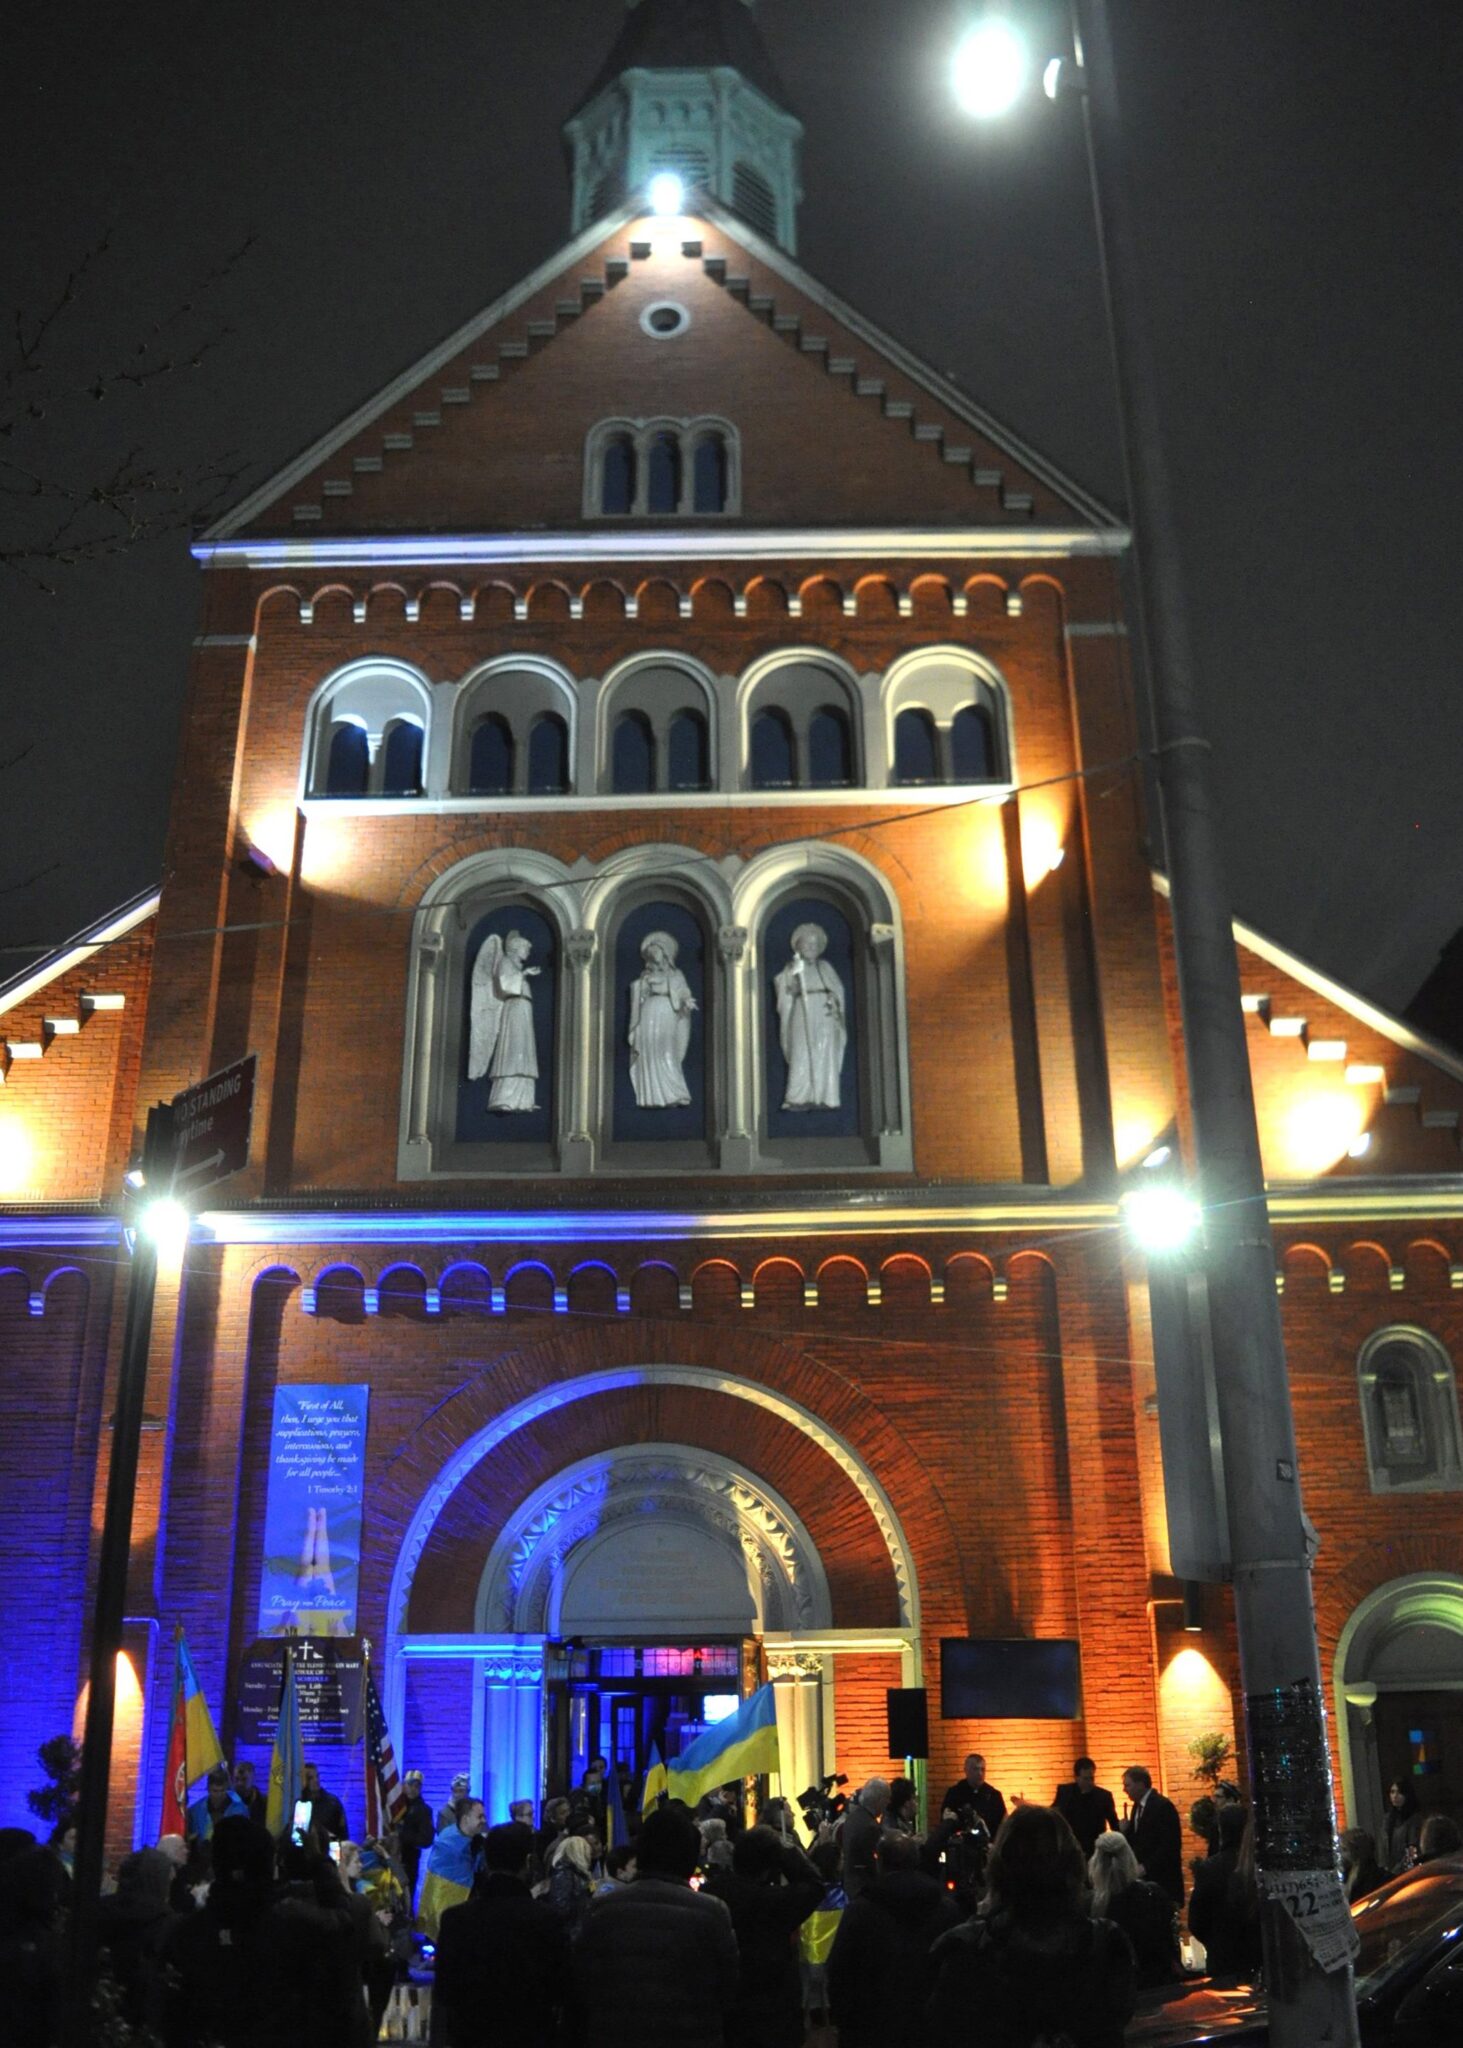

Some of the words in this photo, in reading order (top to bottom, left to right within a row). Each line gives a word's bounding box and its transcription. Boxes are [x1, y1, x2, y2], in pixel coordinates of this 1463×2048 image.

[190, 1074, 241, 1116] STANDING
[320, 1400, 330, 1412] of
[301, 1414, 307, 1424] I
[307, 1416, 324, 1426] urge
[324, 1416, 340, 1425] you
[341, 1413, 359, 1424] that
[335, 1440, 352, 1450] and
[275, 1453, 327, 1466] thanksgiving
[327, 1453, 336, 1464] be
[337, 1453, 359, 1464] made
[285, 1467, 299, 1479] for
[299, 1466, 311, 1477] all
[313, 1485, 344, 1496] Timothy
[346, 1484, 358, 1494] 2:1
[271, 1594, 300, 1613] Pray
[313, 1594, 346, 1608] Peace
[1286, 1891, 1320, 1918] 22
